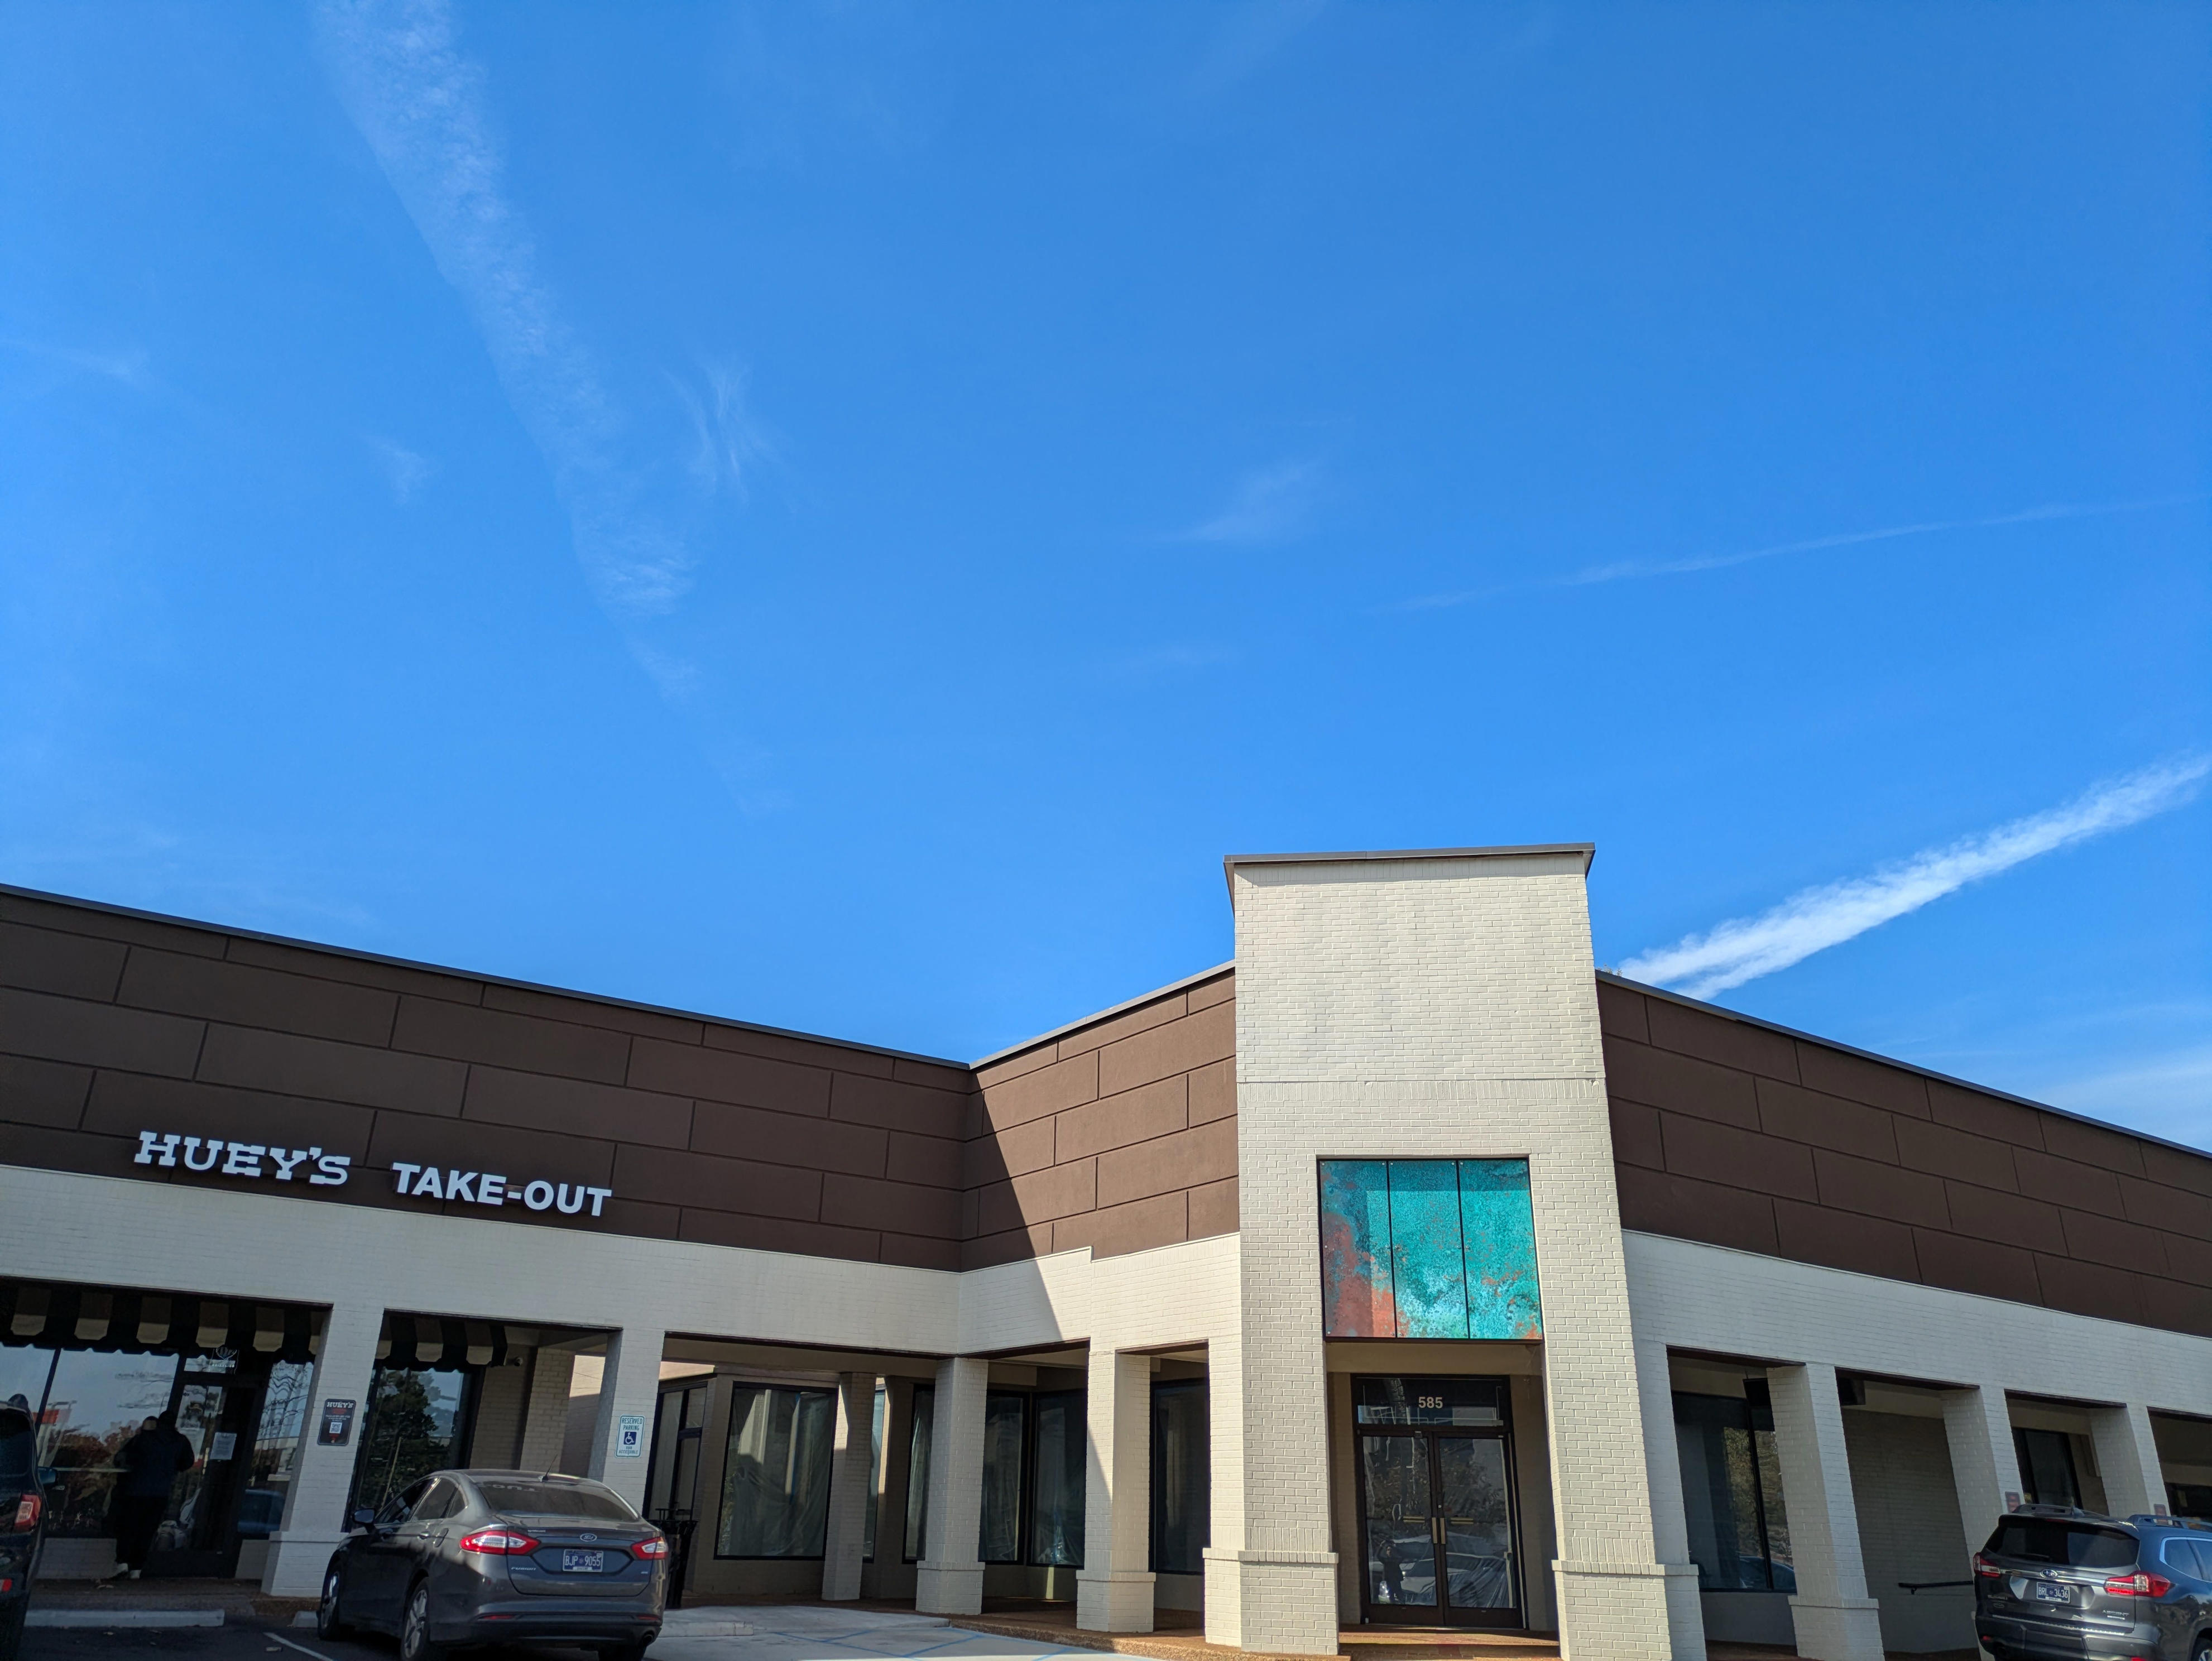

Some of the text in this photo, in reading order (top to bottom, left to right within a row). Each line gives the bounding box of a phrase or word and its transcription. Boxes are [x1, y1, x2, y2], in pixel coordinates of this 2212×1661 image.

[134, 1131, 612, 1216] HUEY'S TAKE-OUT
[1418, 1396, 1443, 1409] 585
[565, 1556, 601, 1566] BJP 9055
[2038, 1587, 2068, 1598] BRL 3436
